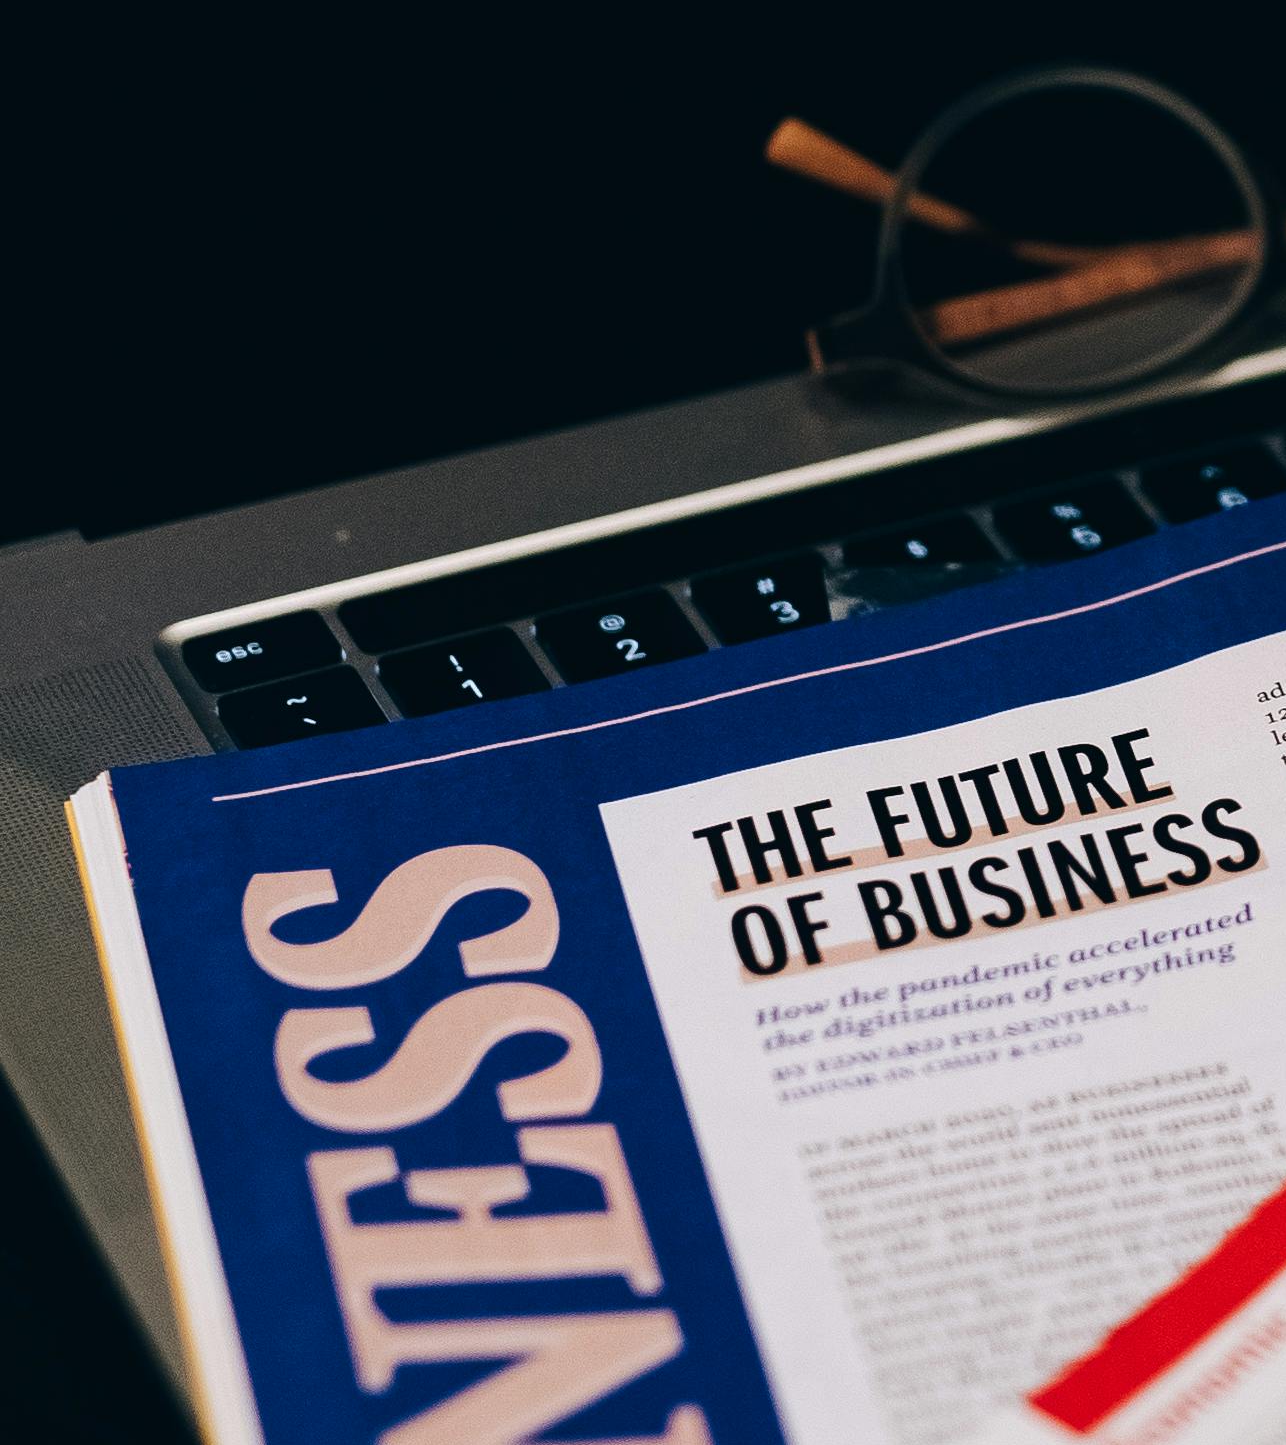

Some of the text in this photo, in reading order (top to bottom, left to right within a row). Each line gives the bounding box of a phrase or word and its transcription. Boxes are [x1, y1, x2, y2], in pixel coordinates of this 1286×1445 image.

[599, 613, 626, 632] @
[770, 601, 800, 623] 3
[616, 639, 648, 661] 2
[461, 679, 483, 699] 1
[692, 727, 1174, 893] THE FUTURE
[730, 799, 1262, 978] OF BUSINESS
[755, 901, 1254, 1027] How the pandemic accelerated
[763, 942, 1237, 1053] the digitization of everything
